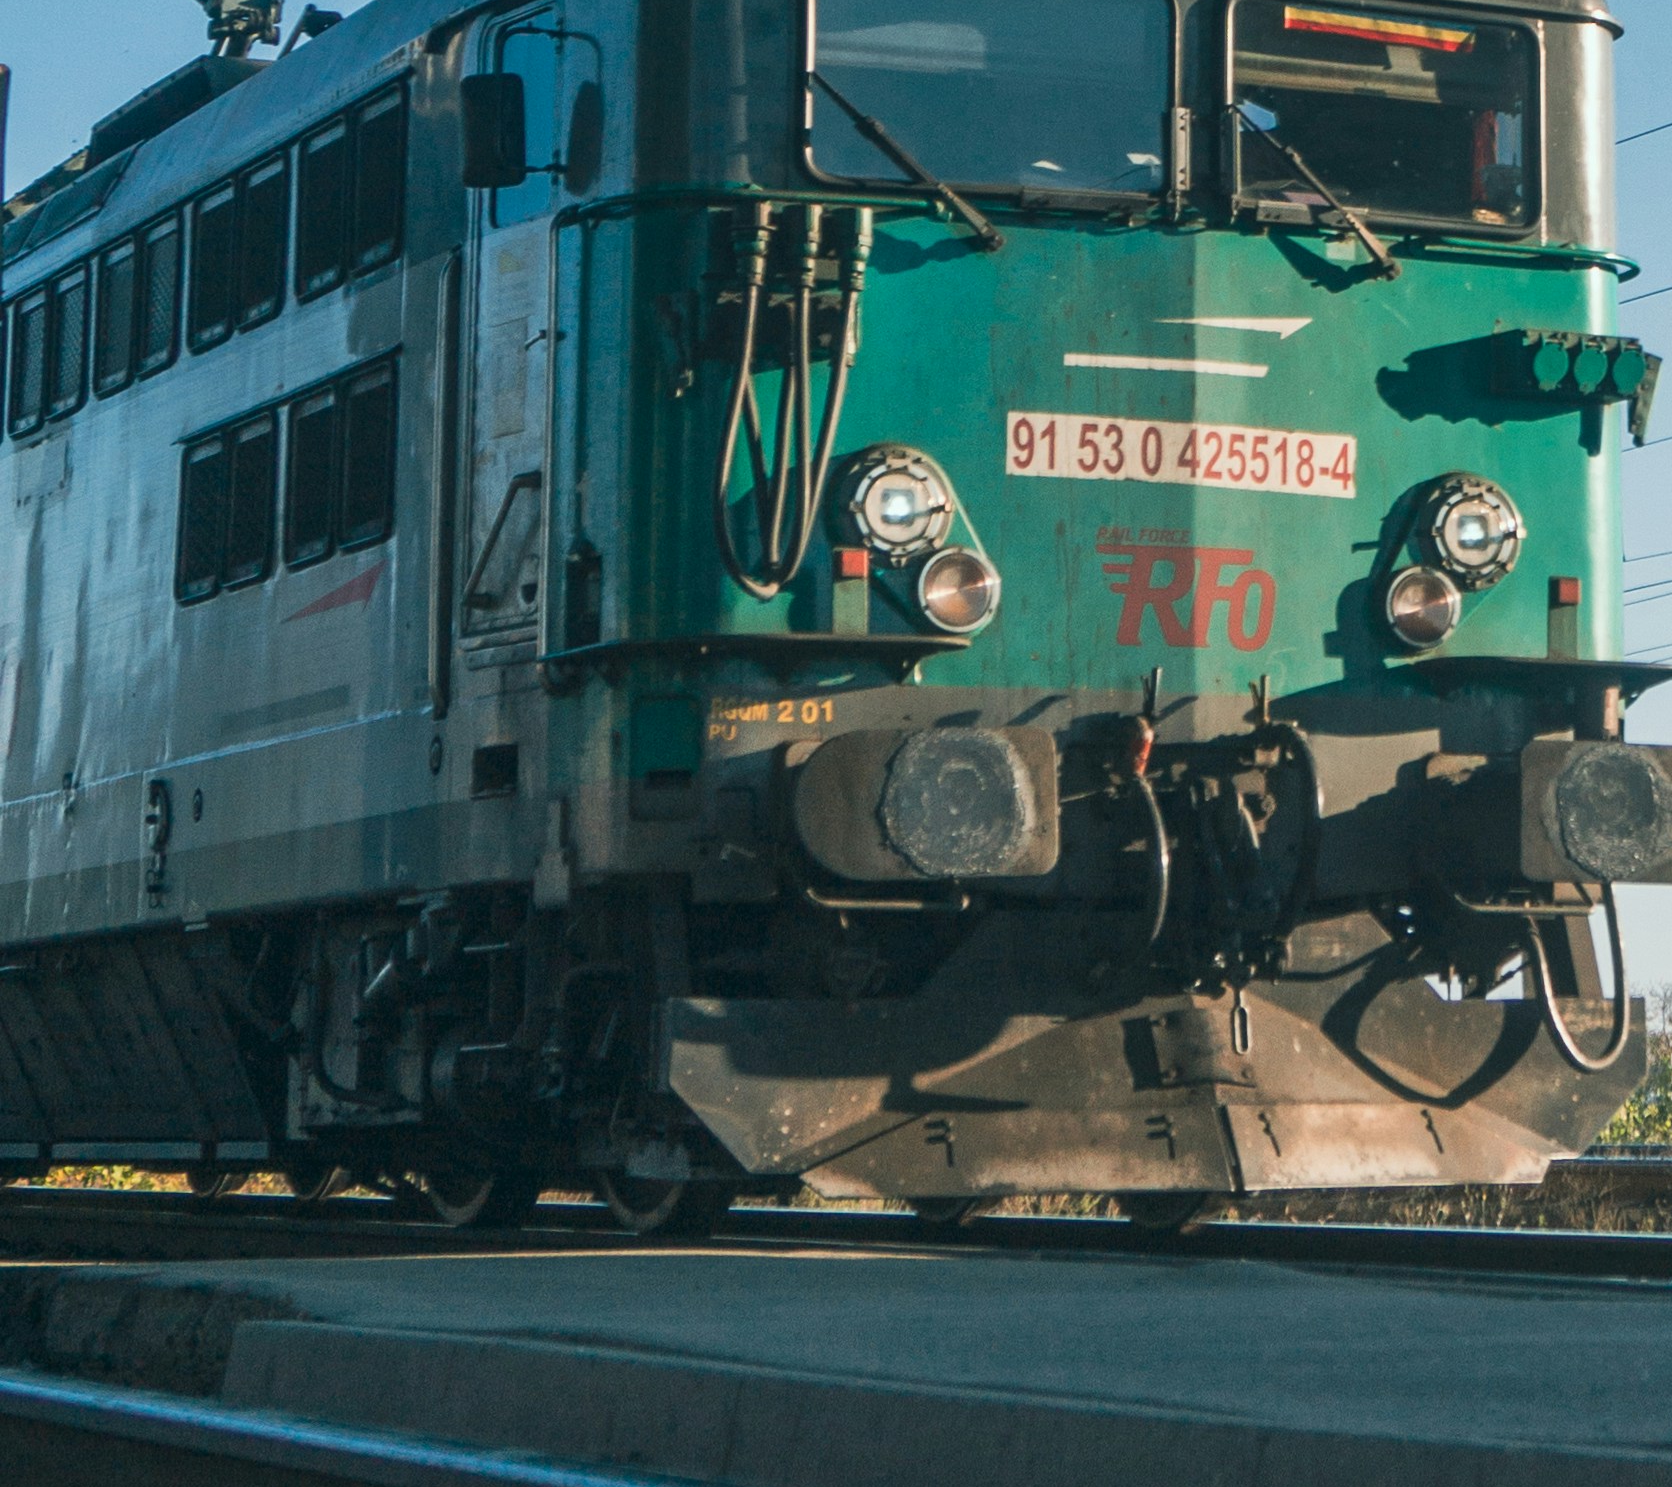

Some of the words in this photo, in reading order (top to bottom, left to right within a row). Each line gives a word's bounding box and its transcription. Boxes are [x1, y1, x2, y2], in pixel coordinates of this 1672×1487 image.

[1012, 417, 1056, 470] 91
[1077, 423, 1125, 475] 53
[1141, 426, 1163, 477] 0
[1177, 428, 1353, 491] 425518-4
[1096, 526, 1133, 542] RAIL
[1138, 528, 1191, 544] FORCE
